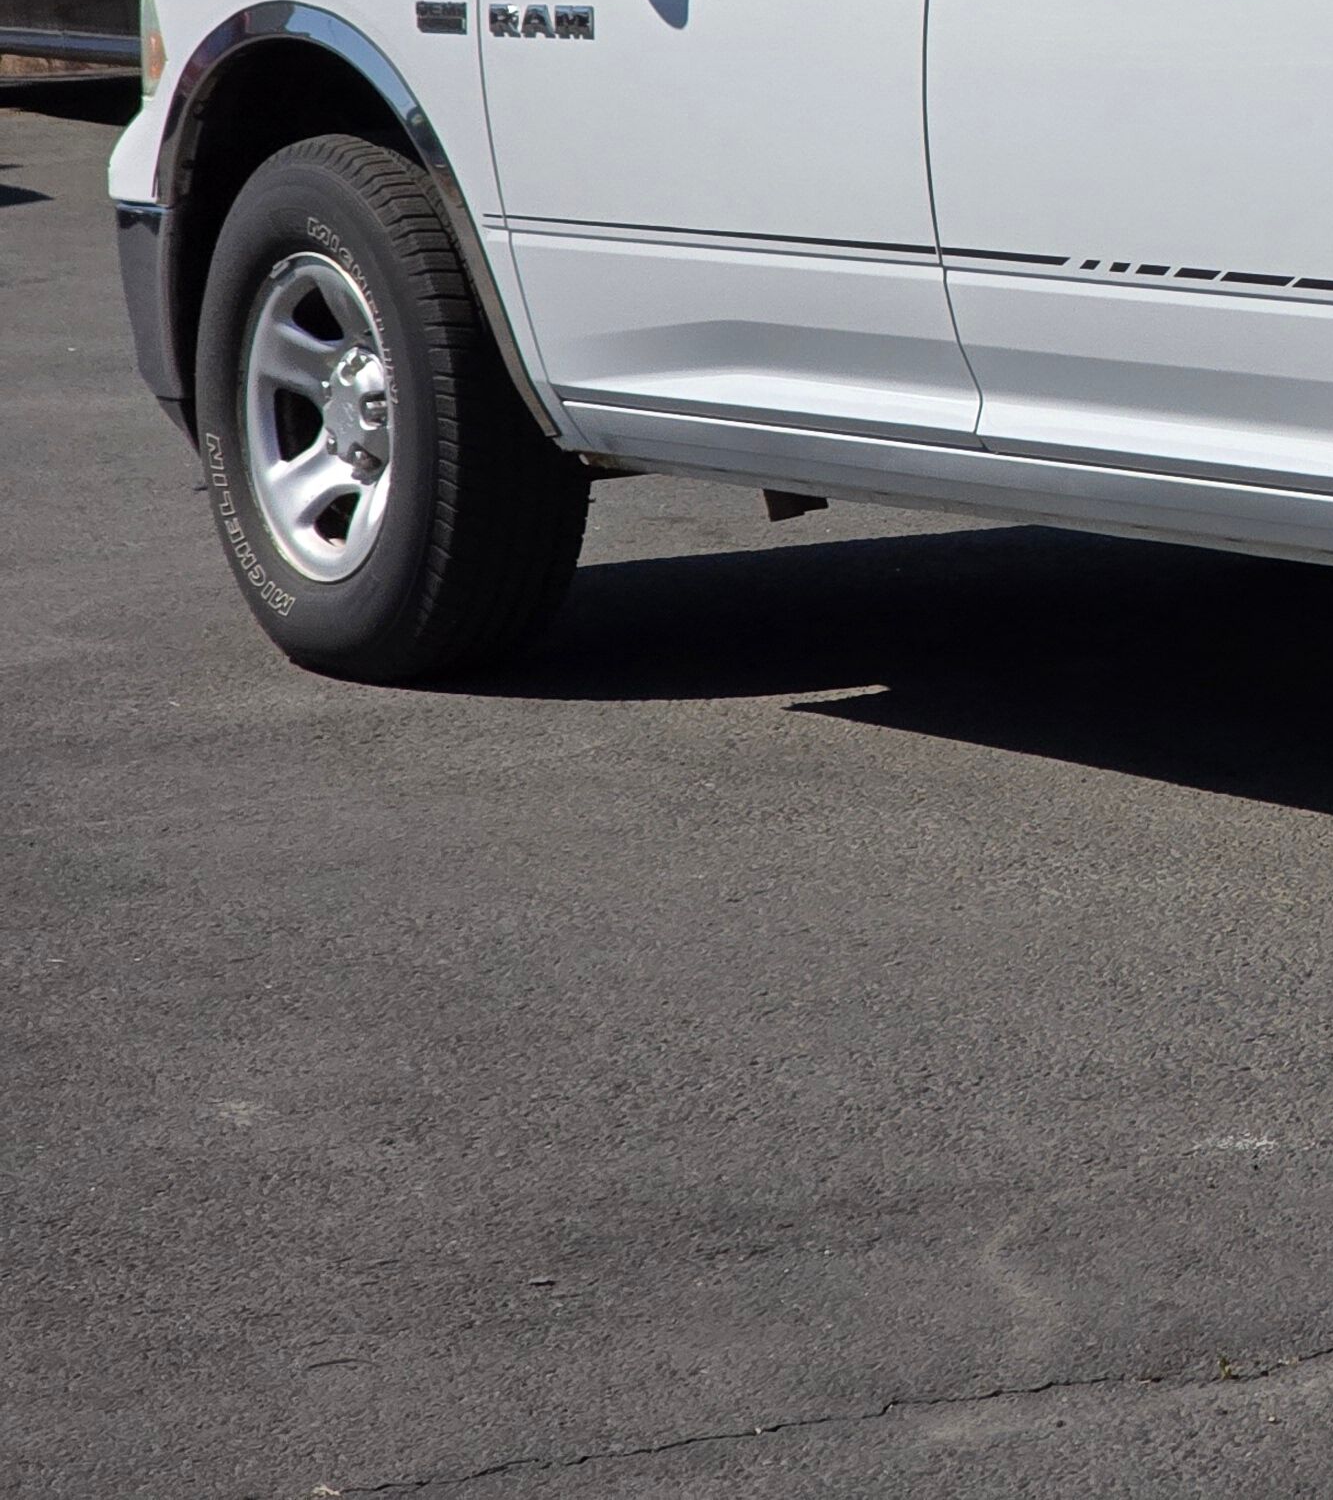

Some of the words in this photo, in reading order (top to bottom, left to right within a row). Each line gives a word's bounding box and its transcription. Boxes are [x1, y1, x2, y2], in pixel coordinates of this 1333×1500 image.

[488, 3, 595, 40] RAM
[308, 216, 398, 405] MICHEIN
[206, 432, 296, 617] MICHELIN
